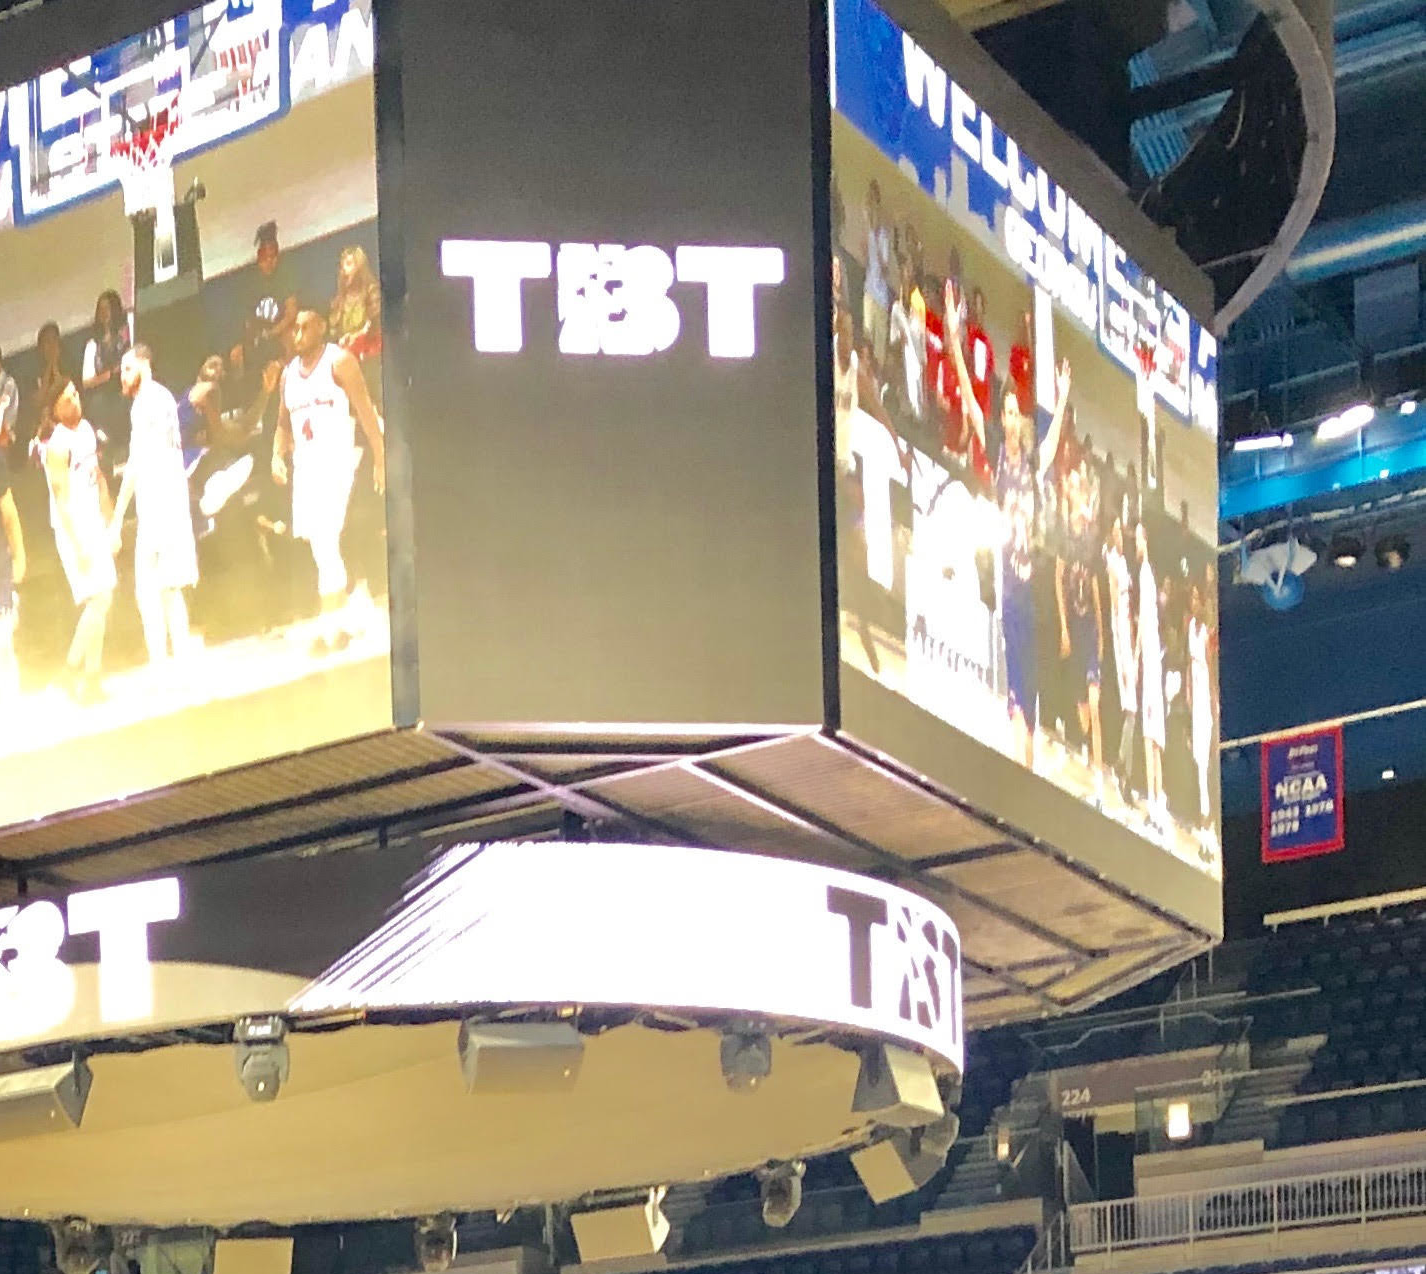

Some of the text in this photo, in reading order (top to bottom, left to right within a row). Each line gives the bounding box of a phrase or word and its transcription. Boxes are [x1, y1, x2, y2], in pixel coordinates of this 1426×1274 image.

[440, 239, 785, 358] TBT
[1275, 773, 1328, 800] NCAA
[1061, 1087, 1091, 1106] 224
